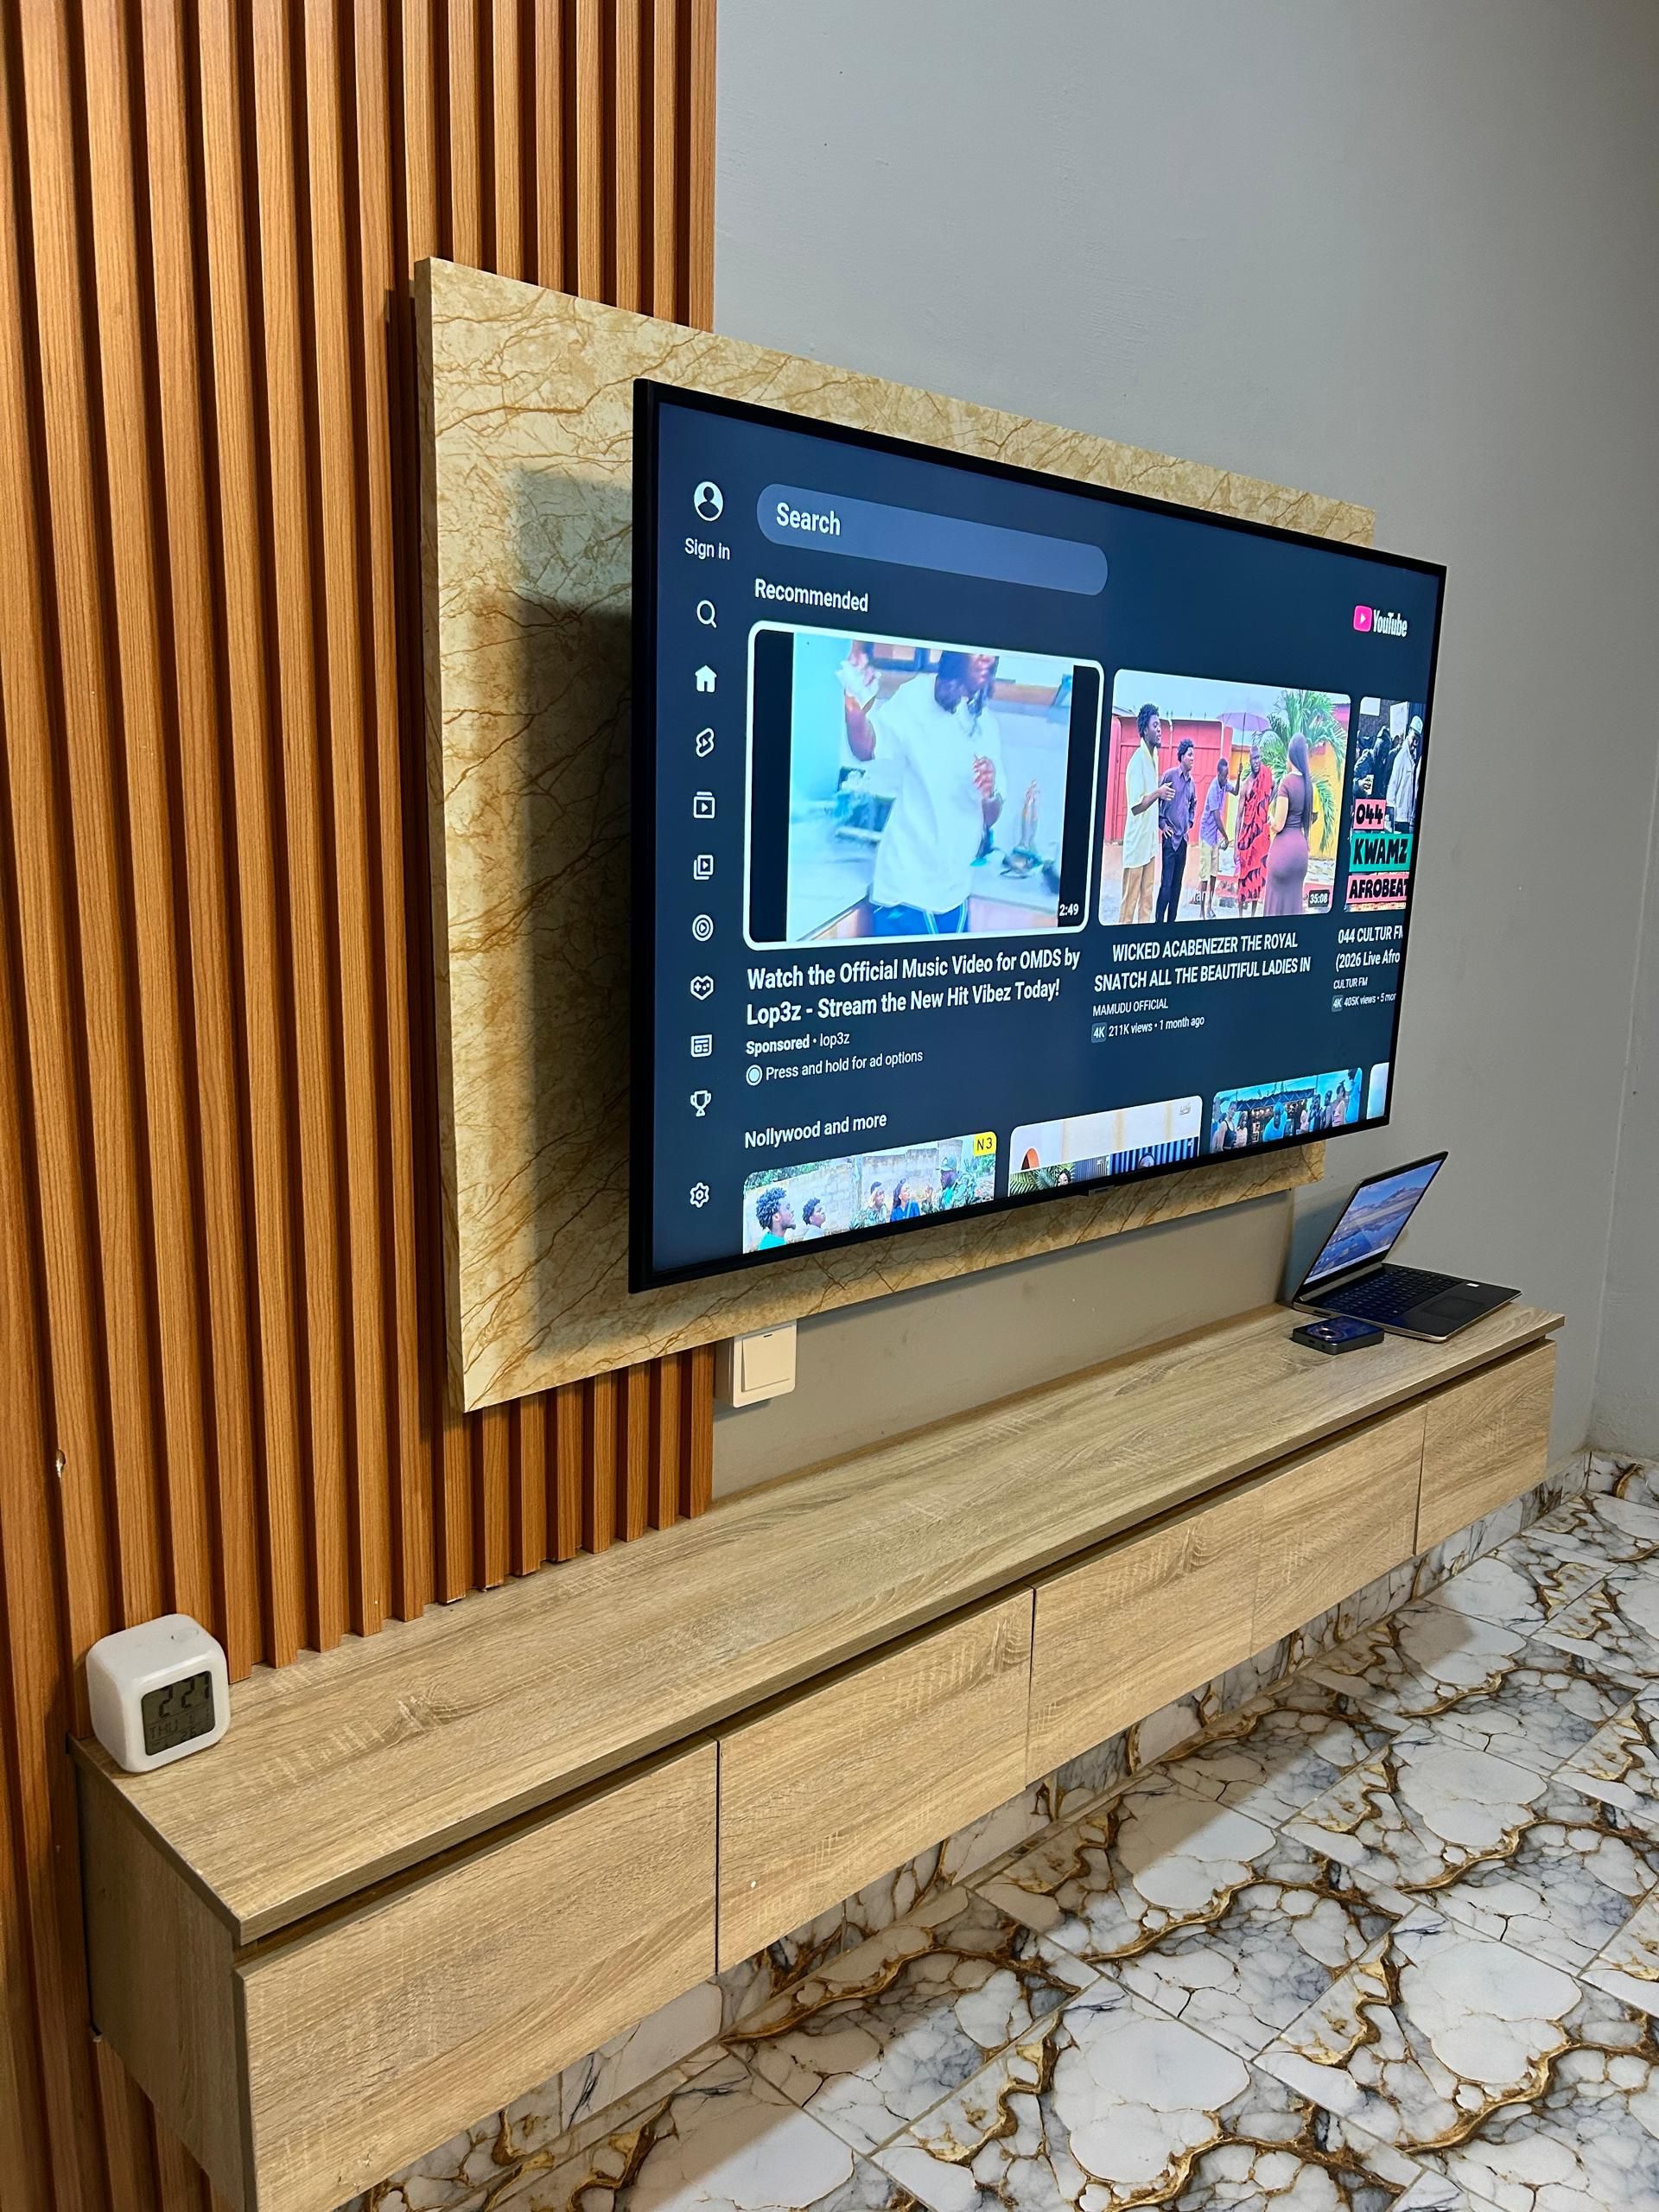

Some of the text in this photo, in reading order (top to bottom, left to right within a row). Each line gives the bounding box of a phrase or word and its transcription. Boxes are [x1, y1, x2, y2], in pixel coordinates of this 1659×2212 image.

[777, 502, 841, 536] Search
[685, 537, 730, 560] Sign in
[754, 578, 868, 612] Recommended
[1373, 609, 1408, 638] YouTube
[1356, 804, 1383, 824] 044
[1353, 838, 1408, 865] KWAMZ
[1059, 903, 1079, 916] 2:49
[1310, 893, 1328, 904] 35:08
[1112, 932, 1298, 962] WICKED ACABENEZER THE ROYAL
[1338, 928, 1356, 944] 044
[1357, 925, 1392, 943] CULTUR
[747, 947, 1080, 990] Watch the Official Music Video for OMDS by
[1336, 948, 1401, 972] (2026 Live Afro
[1094, 957, 1312, 992] SNATCH ALL THE BEAUTIFUL LADIES IN
[1333, 976, 1369, 989] CULTUR FM
[747, 1001, 802, 1028] Lop3z
[817, 998, 877, 1019] Stream
[881, 992, 906, 1013] the
[911, 990, 944, 1010] New
[947, 986, 969, 1007] Hit
[972, 983, 1011, 1004] Vibez
[1014, 978, 1060, 1001] Today!
[1092, 998, 1169, 1017] MAMUDU OFFICIAL
[1332, 998, 1342, 1008] 4K
[1344, 996, 1359, 1007] 405K
[1360, 995, 1376, 1005] views
[1380, 993, 1385, 1002] 5
[1093, 1016, 1205, 1039] 4K 211K views 1 month ago
[746, 1032, 850, 1057] Sponsored lop3z
[766, 1051, 924, 1081] Press and hold for ad options
[745, 1114, 887, 1148] Nollywood and more
